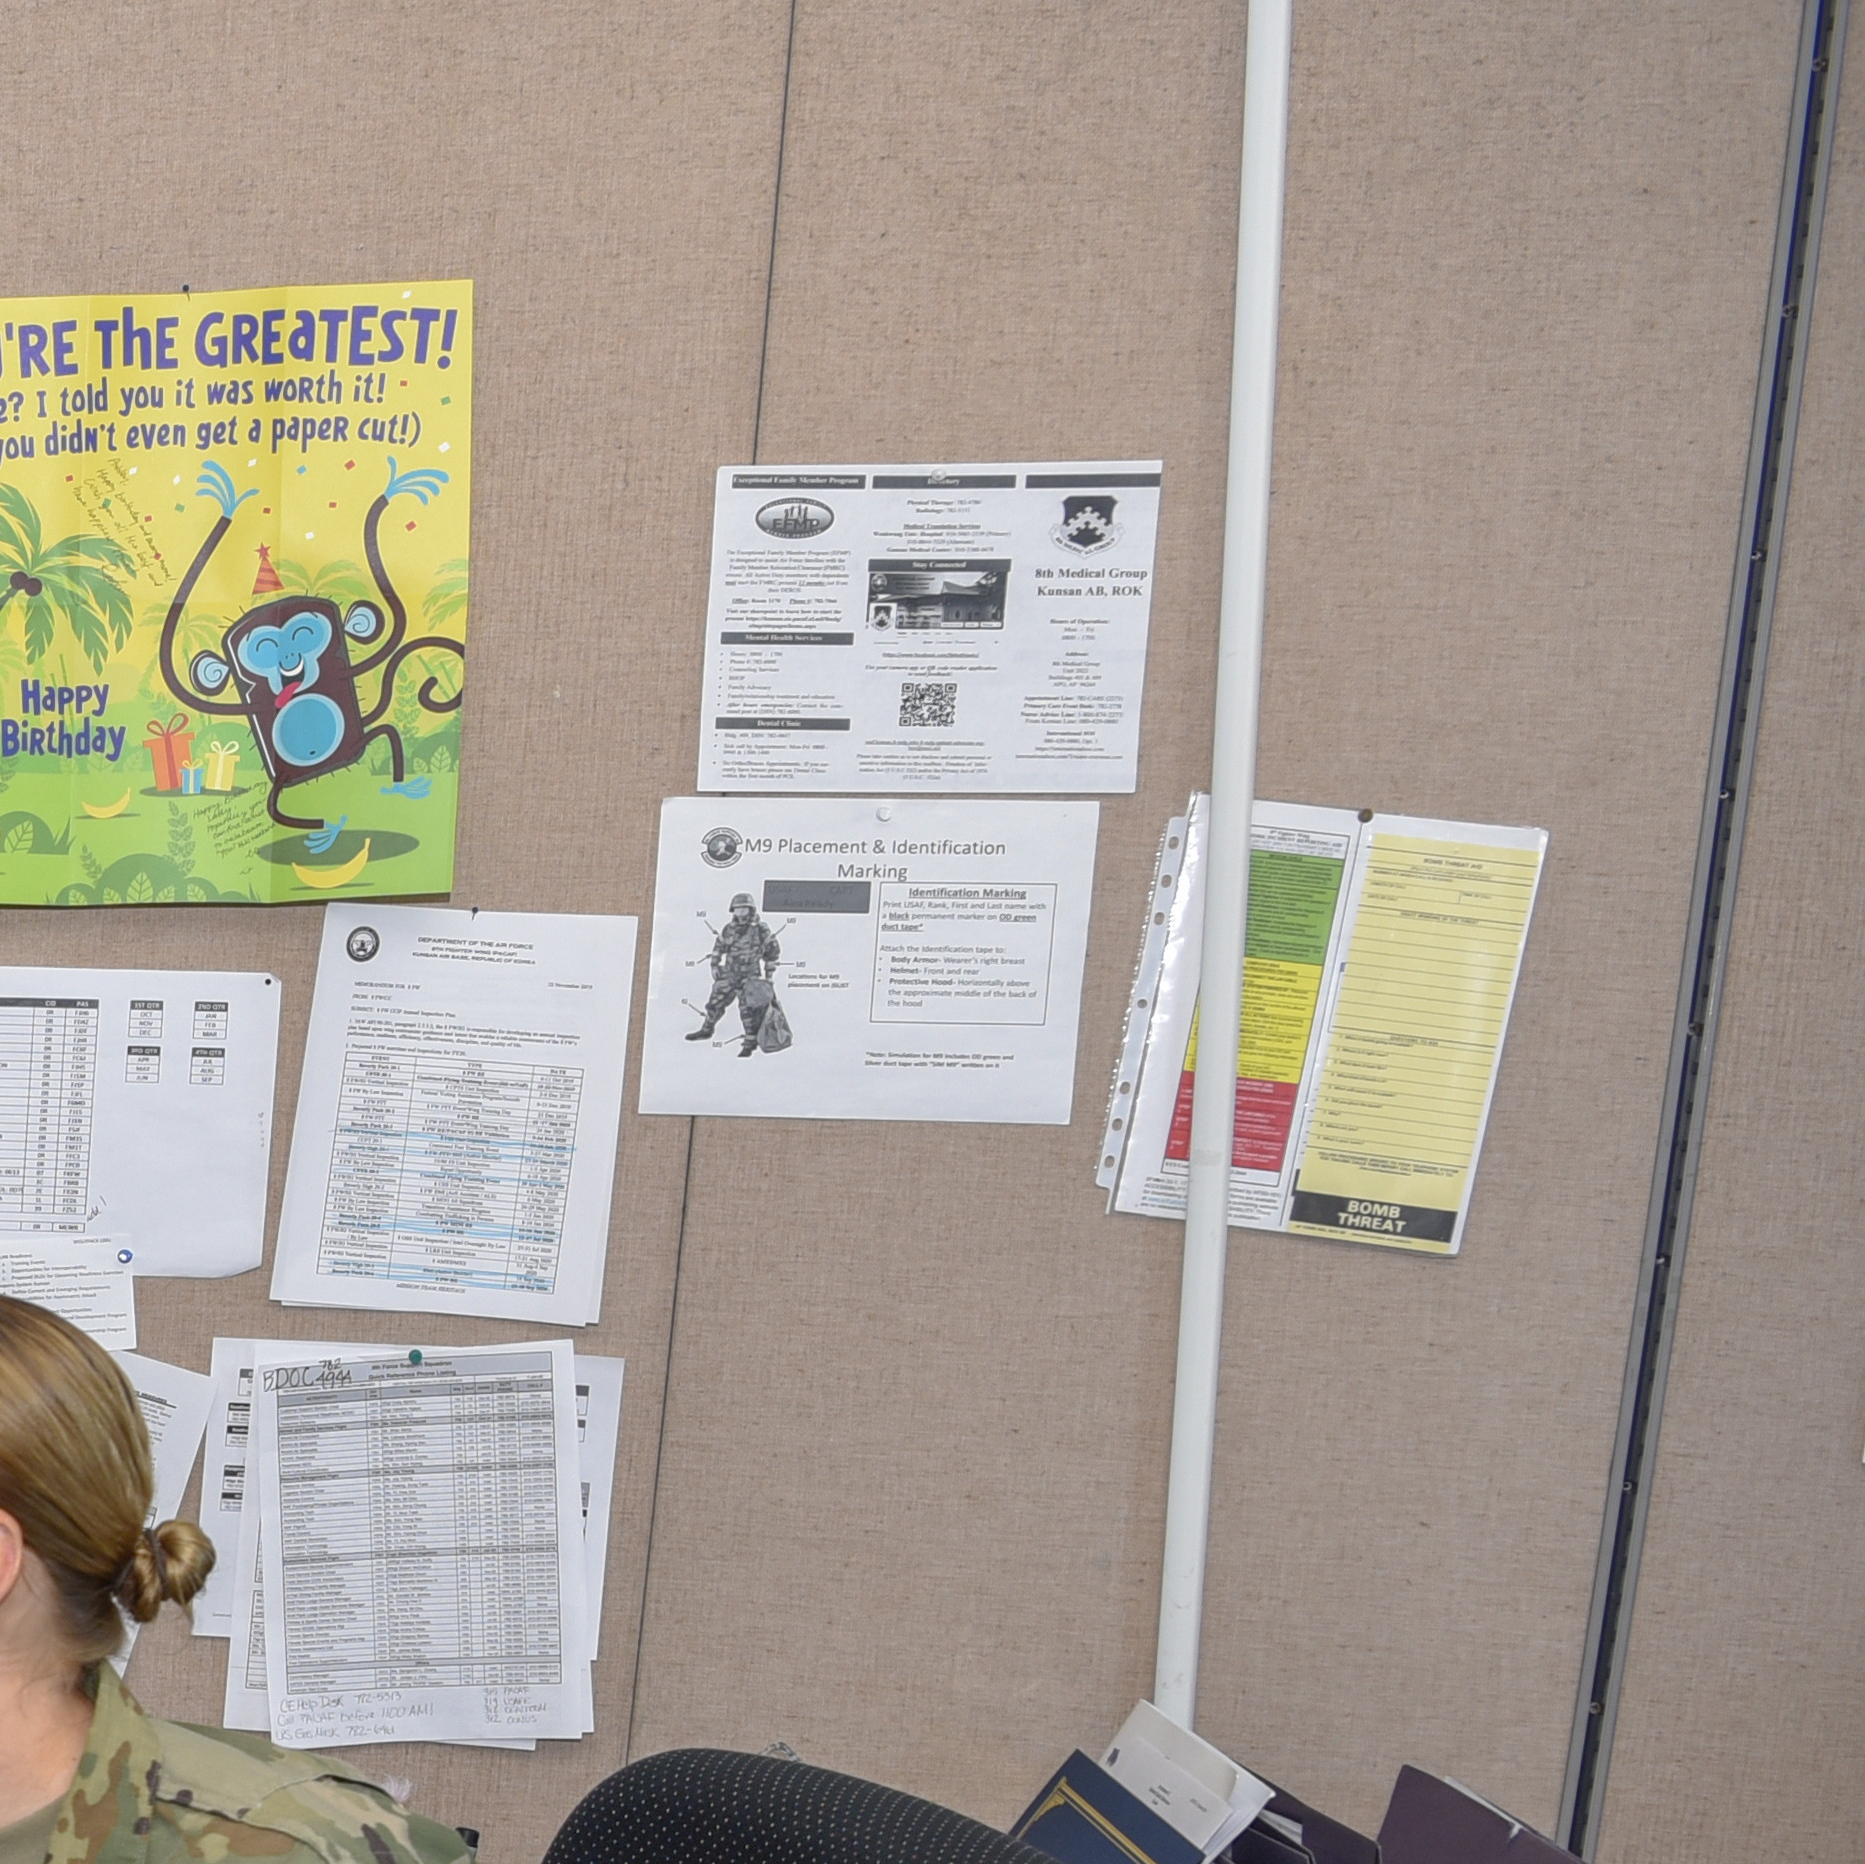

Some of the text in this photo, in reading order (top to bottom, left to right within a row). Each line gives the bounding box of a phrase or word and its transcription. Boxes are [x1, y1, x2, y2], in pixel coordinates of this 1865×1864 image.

[37, 390, 47, 418] I
[60, 377, 109, 416] told
[119, 384, 163, 415] you
[175, 378, 195, 408] it
[207, 380, 254, 406] was
[354, 373, 385, 402] it!
[126, 425, 187, 450] even
[197, 414, 238, 454] get
[248, 417, 261, 442] a
[357, 411, 422, 446] cut!)
[1034, 568, 1148, 581] 8th Medical Group
[1037, 586, 1143, 597] Kunsan AB, ROK
[20, 679, 110, 716] Happy
[0, 718, 127, 762] Birthday
[744, 837, 1006, 858] M9 Placement & Identification
[837, 863, 909, 882] Marking
[909, 888, 1027, 899] Identification Marking
[1347, 1200, 1401, 1219] BOMB
[1337, 1212, 1407, 1234] THREAT
